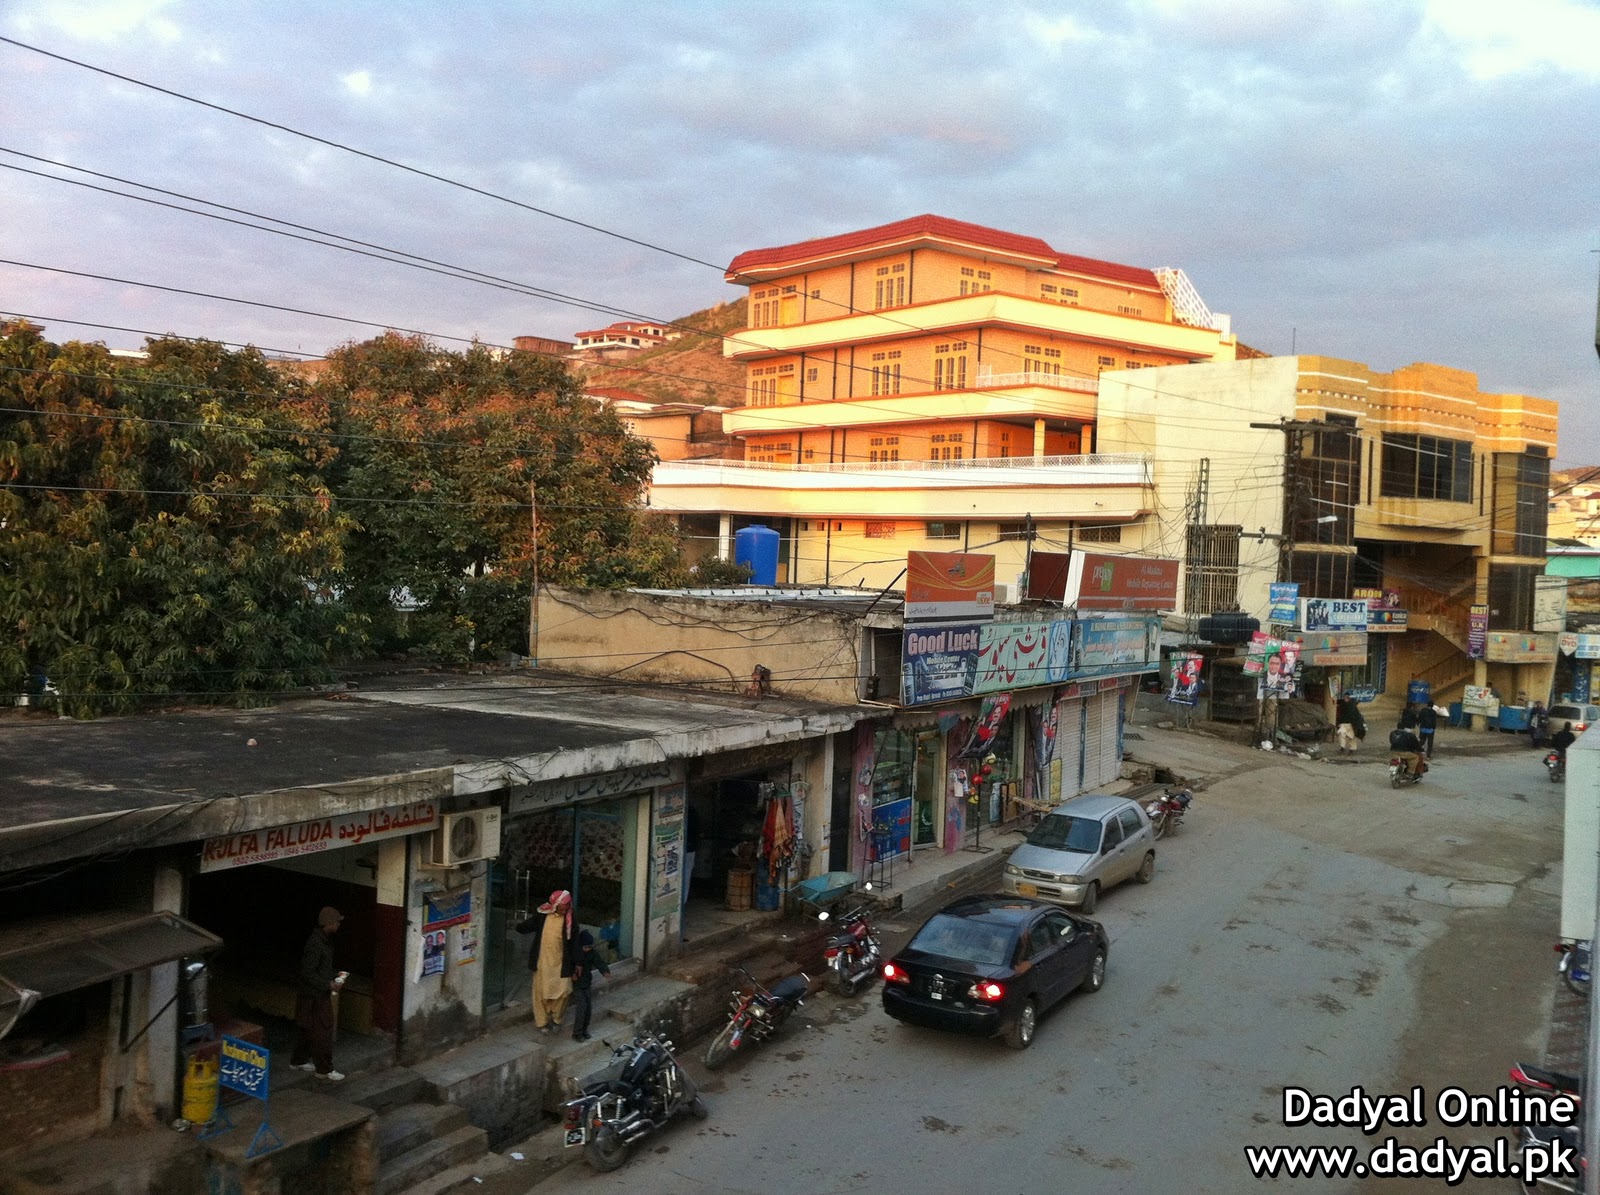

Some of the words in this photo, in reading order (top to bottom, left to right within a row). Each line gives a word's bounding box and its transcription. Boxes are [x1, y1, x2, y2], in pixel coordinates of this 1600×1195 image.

[1333, 602, 1365, 613] BEST
[1470, 606, 1487, 615] BEST
[907, 631, 946, 657] Good
[947, 629, 979, 653] Luck
[265, 820, 334, 851] FALUDA
